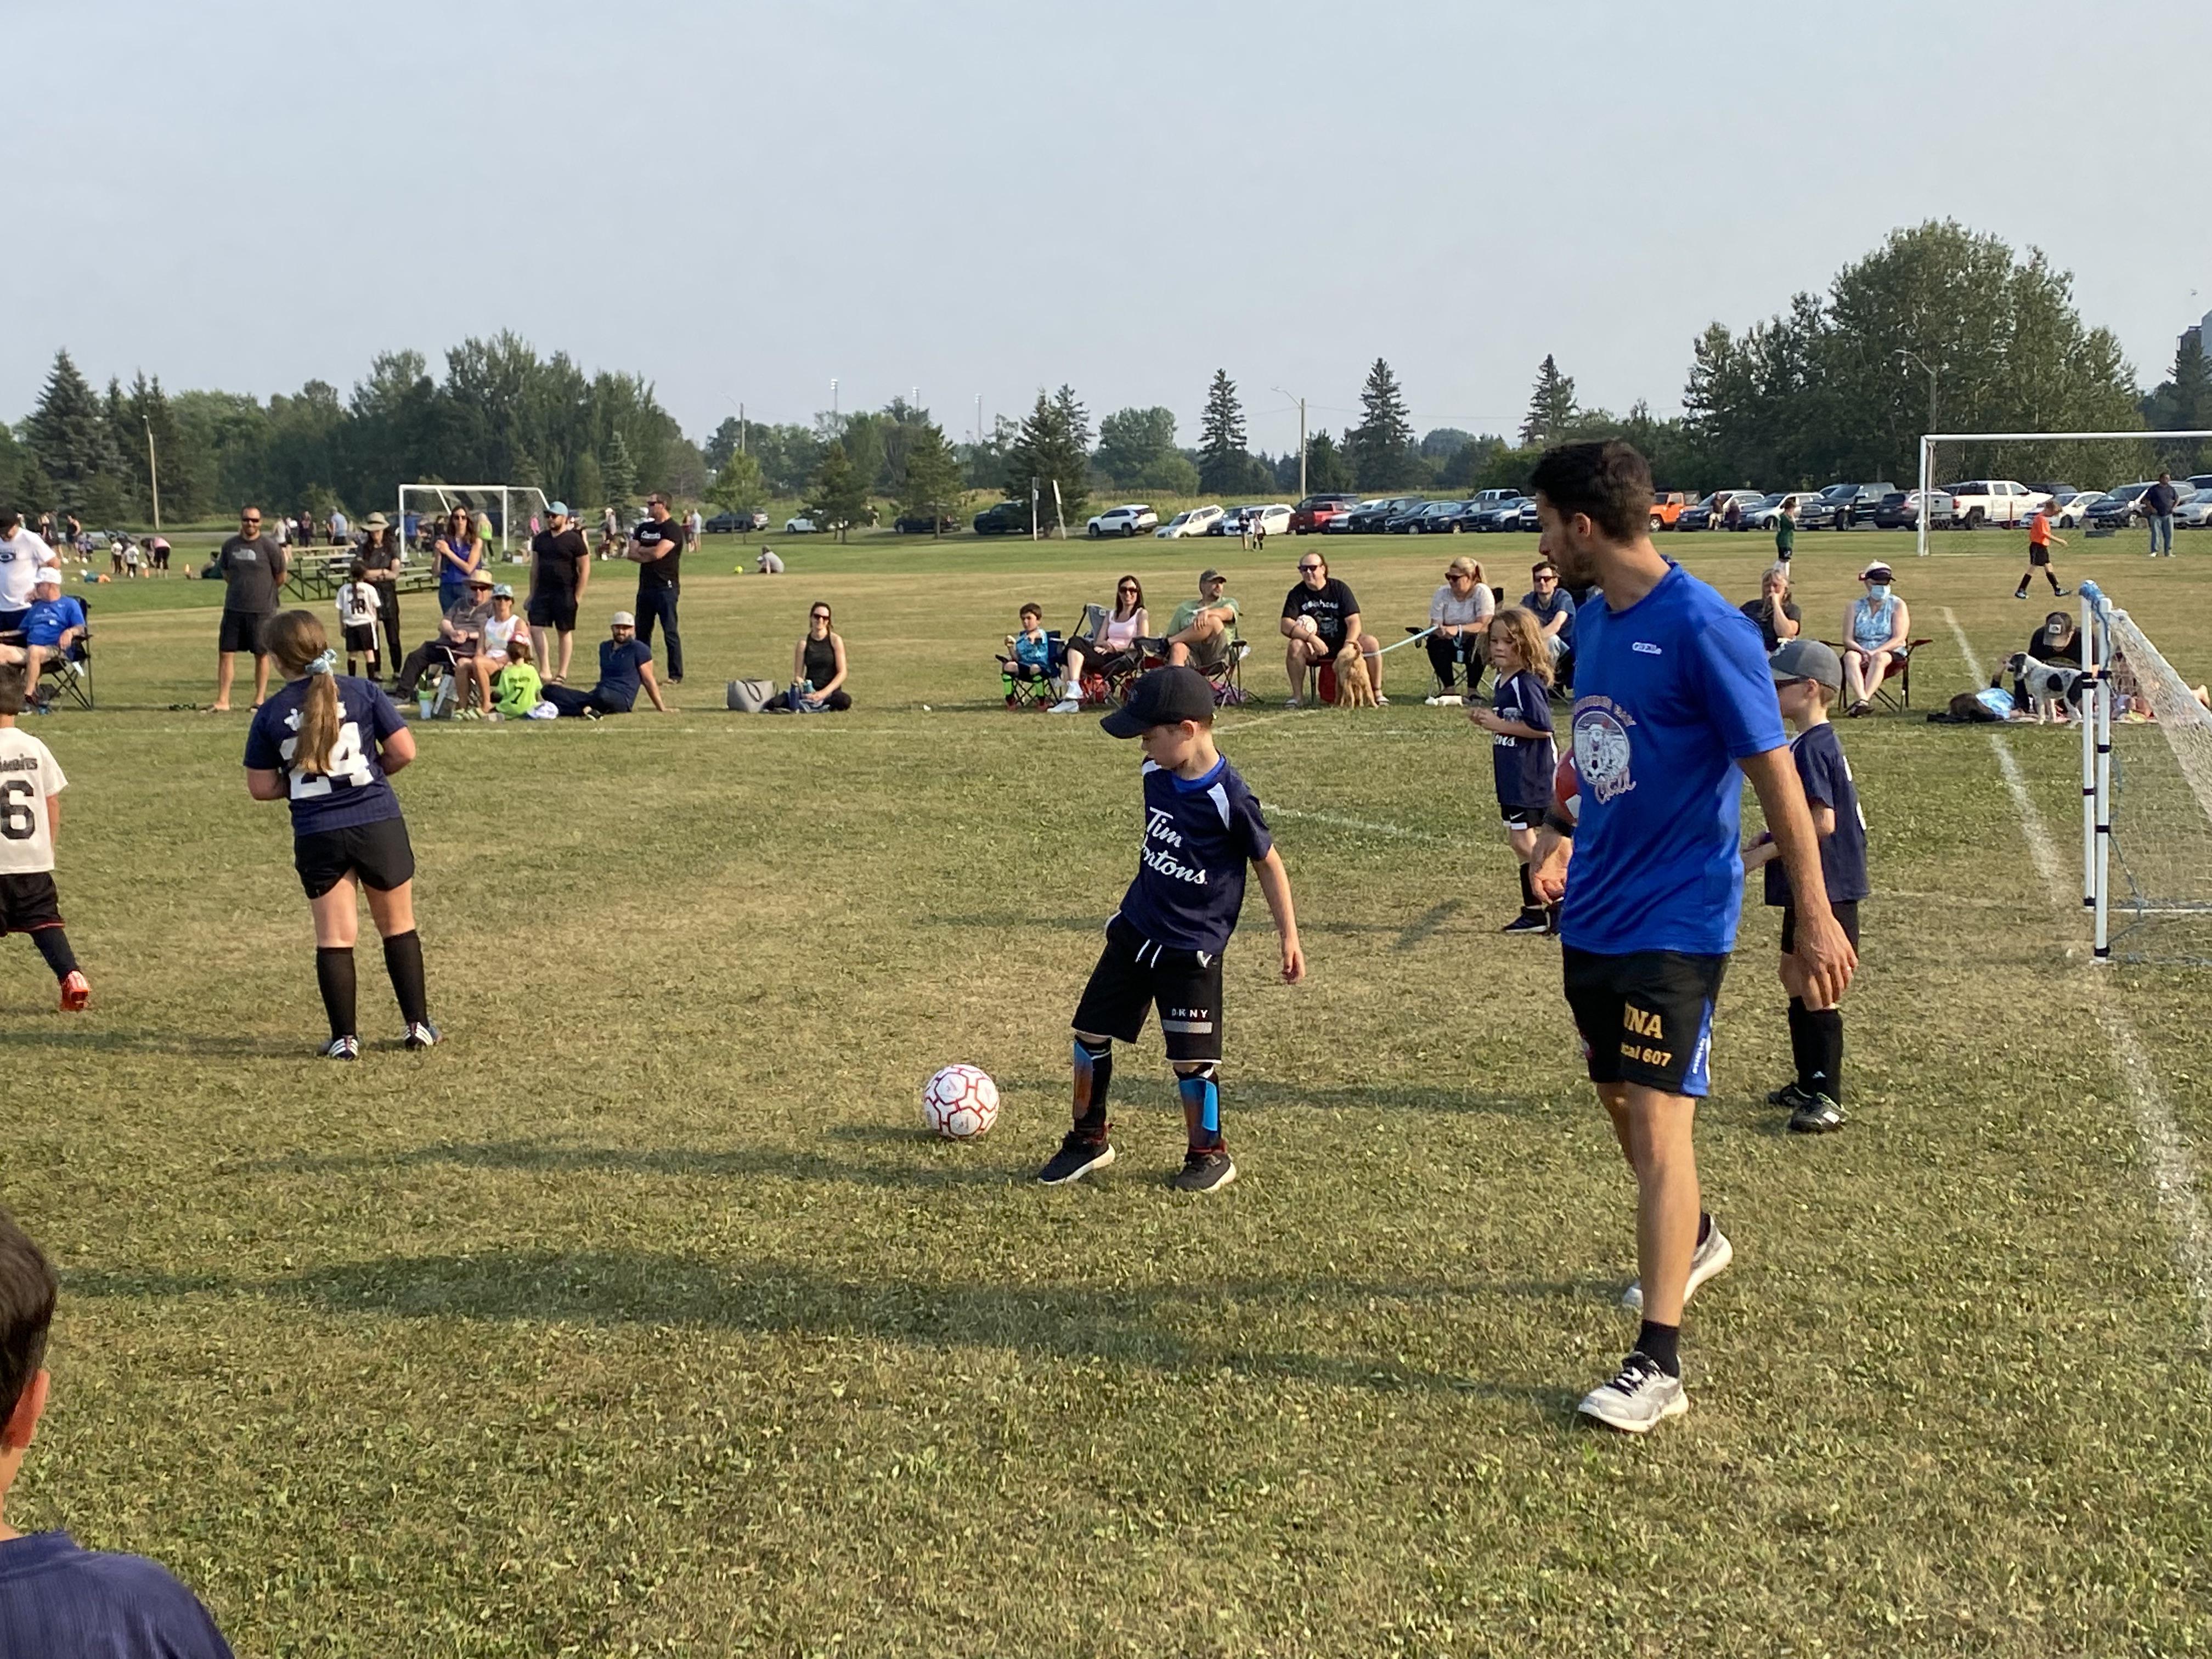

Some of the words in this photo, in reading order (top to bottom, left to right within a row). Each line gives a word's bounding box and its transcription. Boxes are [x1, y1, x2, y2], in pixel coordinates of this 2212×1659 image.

[511, 685, 524, 704] 7
[279, 721, 374, 799] 24
[0, 780, 36, 840] 6
[1147, 806, 1182, 848] Tim
[1171, 1008, 1208, 1019] DKNY
[1643, 1048, 1672, 1066] 607
